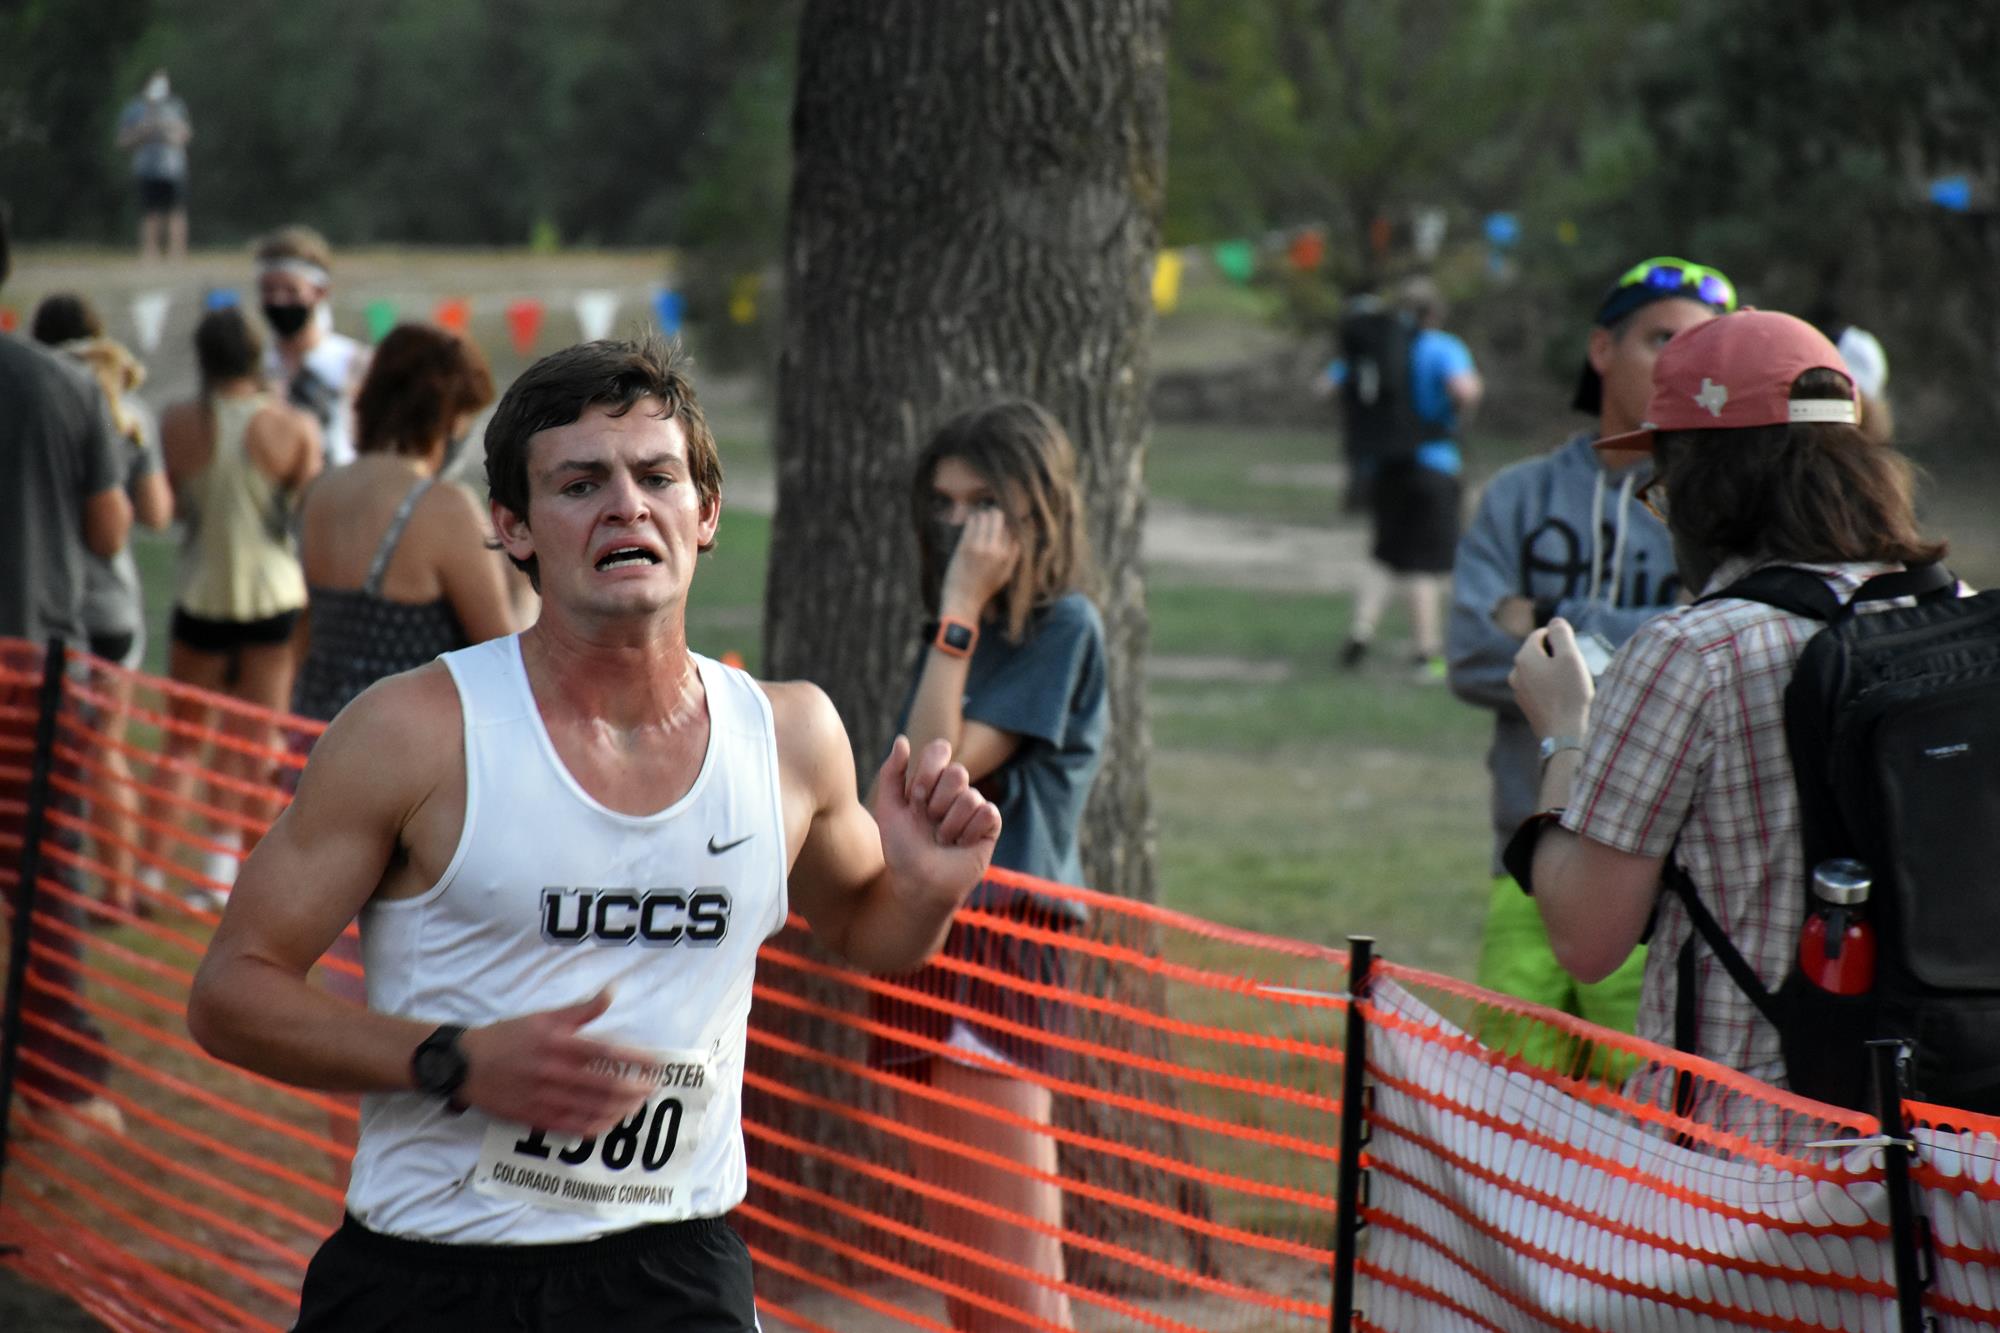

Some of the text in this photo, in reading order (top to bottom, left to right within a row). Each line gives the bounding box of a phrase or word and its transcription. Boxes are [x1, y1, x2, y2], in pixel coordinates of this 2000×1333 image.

[539, 886, 733, 949] UCCS
[493, 1161, 675, 1208] COLORADO RUNNING COMPANY
